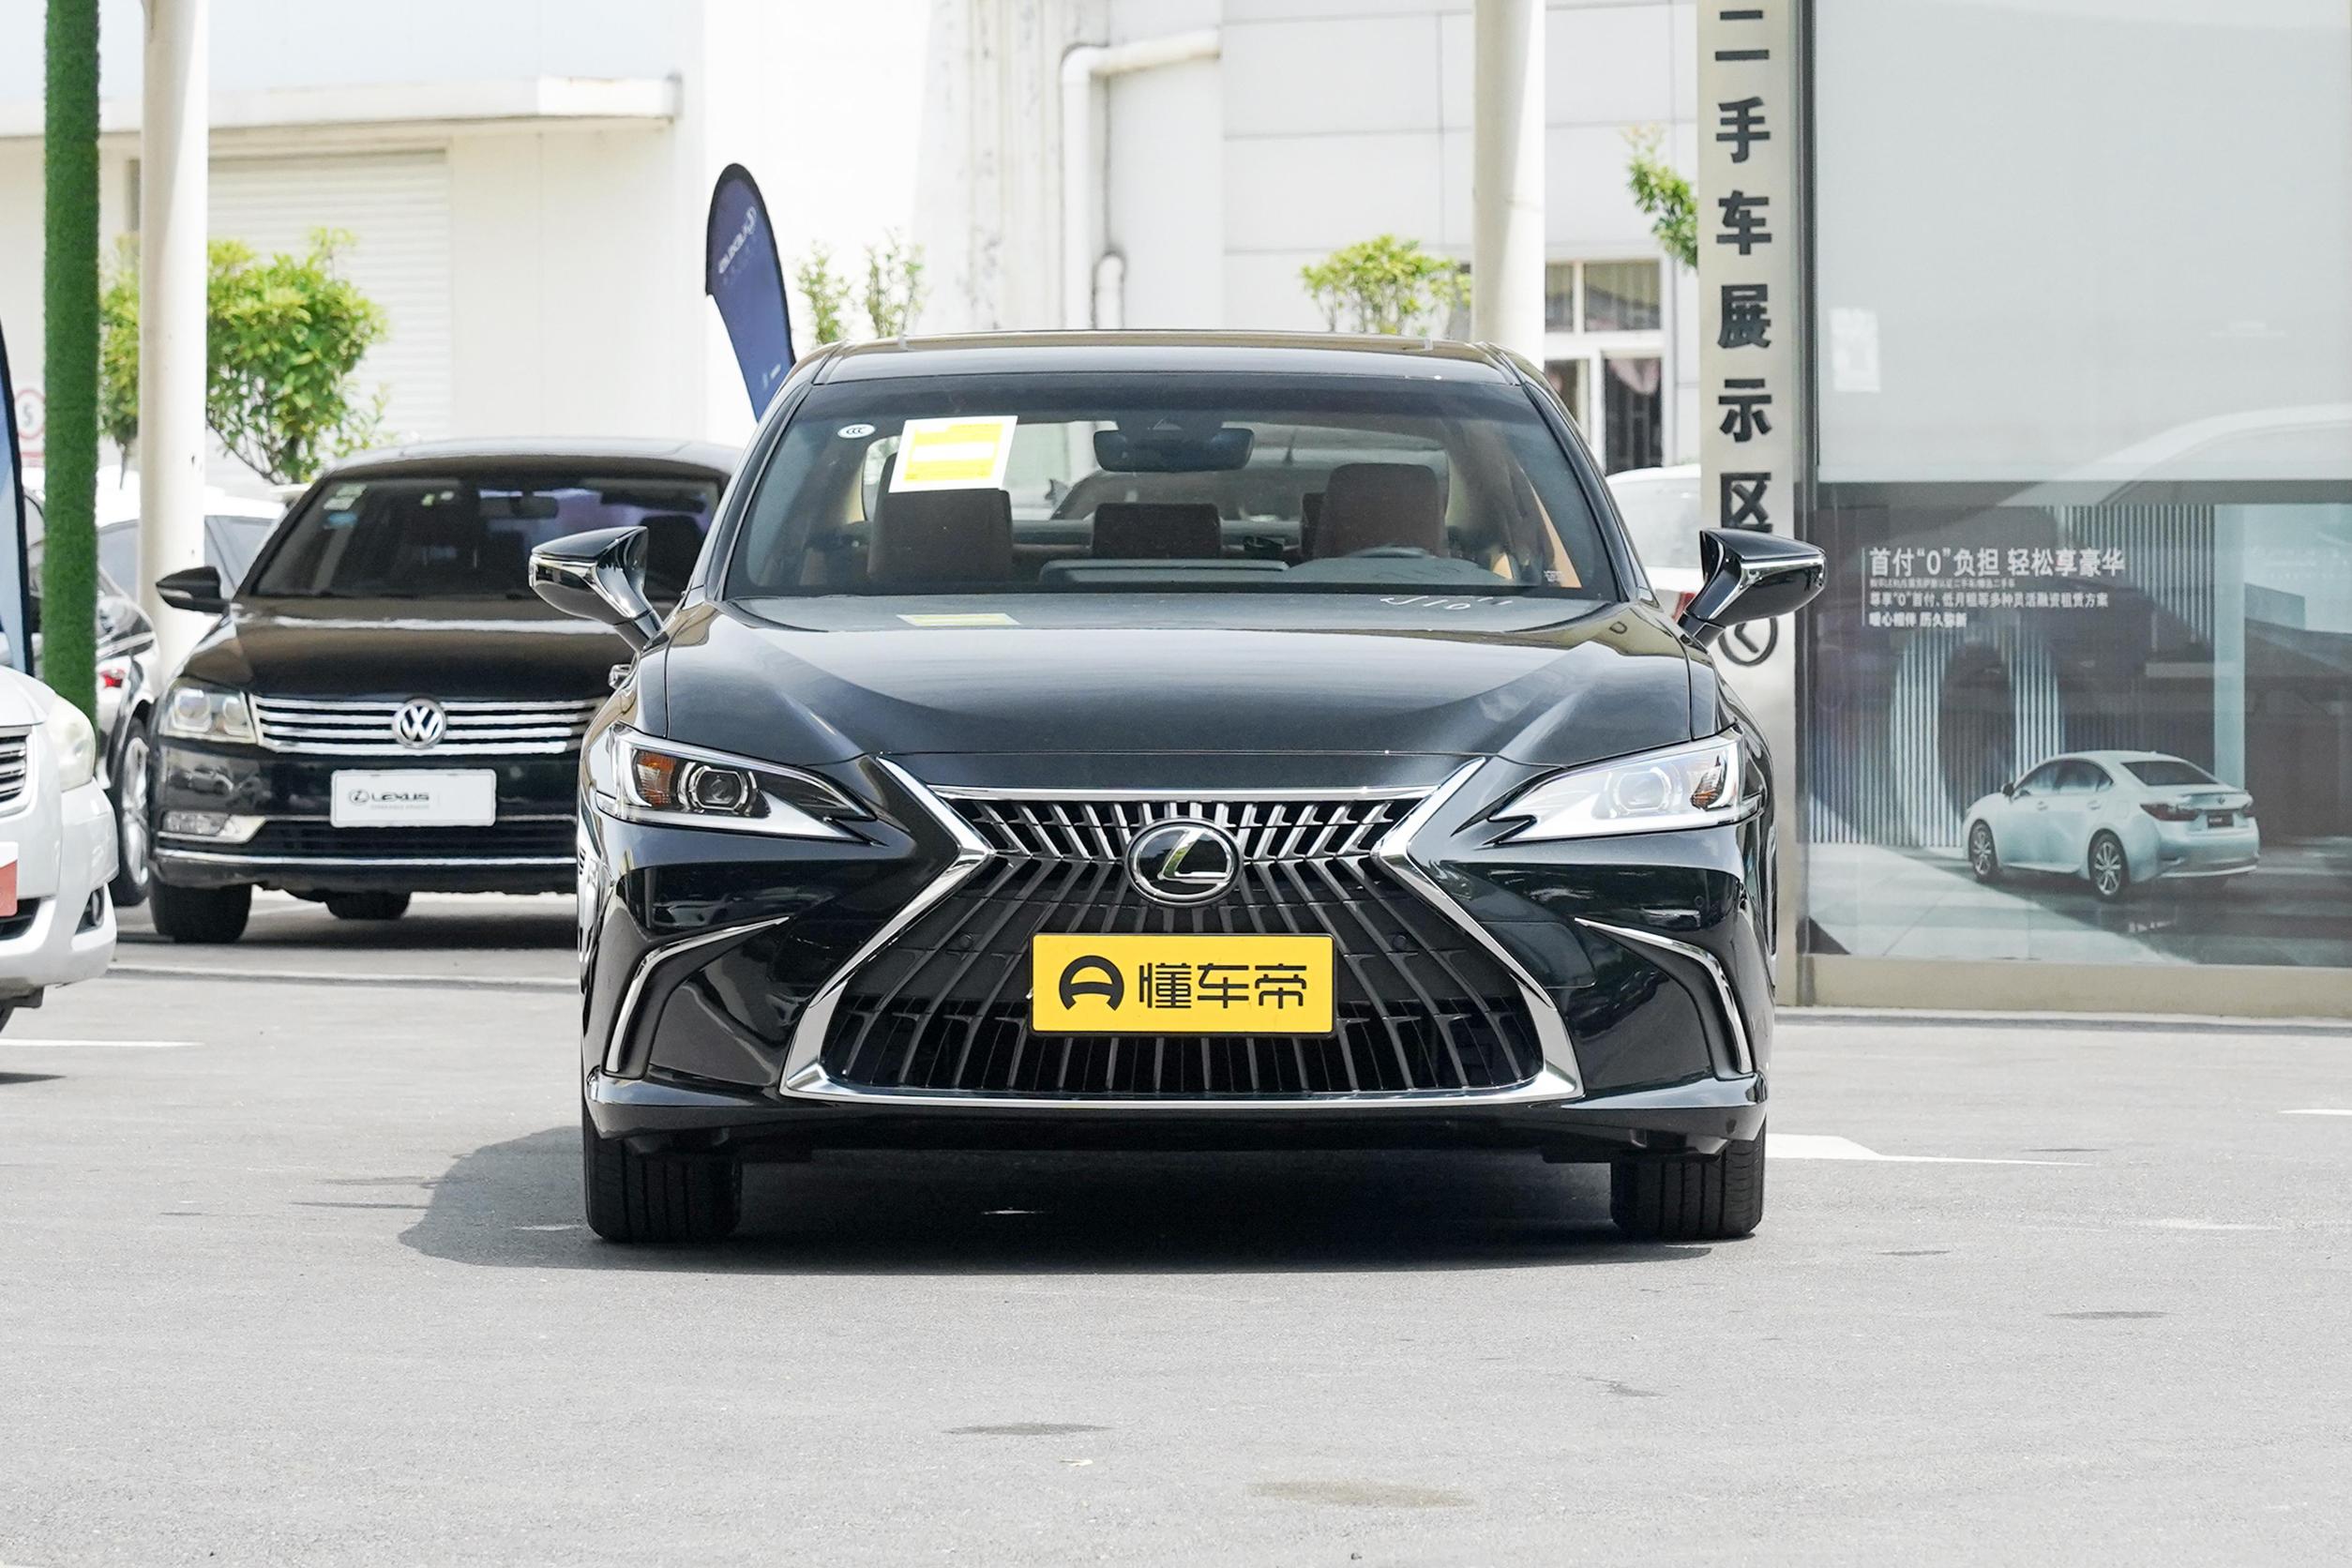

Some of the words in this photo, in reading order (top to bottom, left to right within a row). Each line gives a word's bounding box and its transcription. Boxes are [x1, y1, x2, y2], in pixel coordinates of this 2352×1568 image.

[1713, 9, 1773, 534] 二手车展示区
[2007, 547, 2126, 577] 轻松享豪华
[370, 792, 430, 803] LEXUS
[1138, 962, 1307, 1010] 懂车帝
